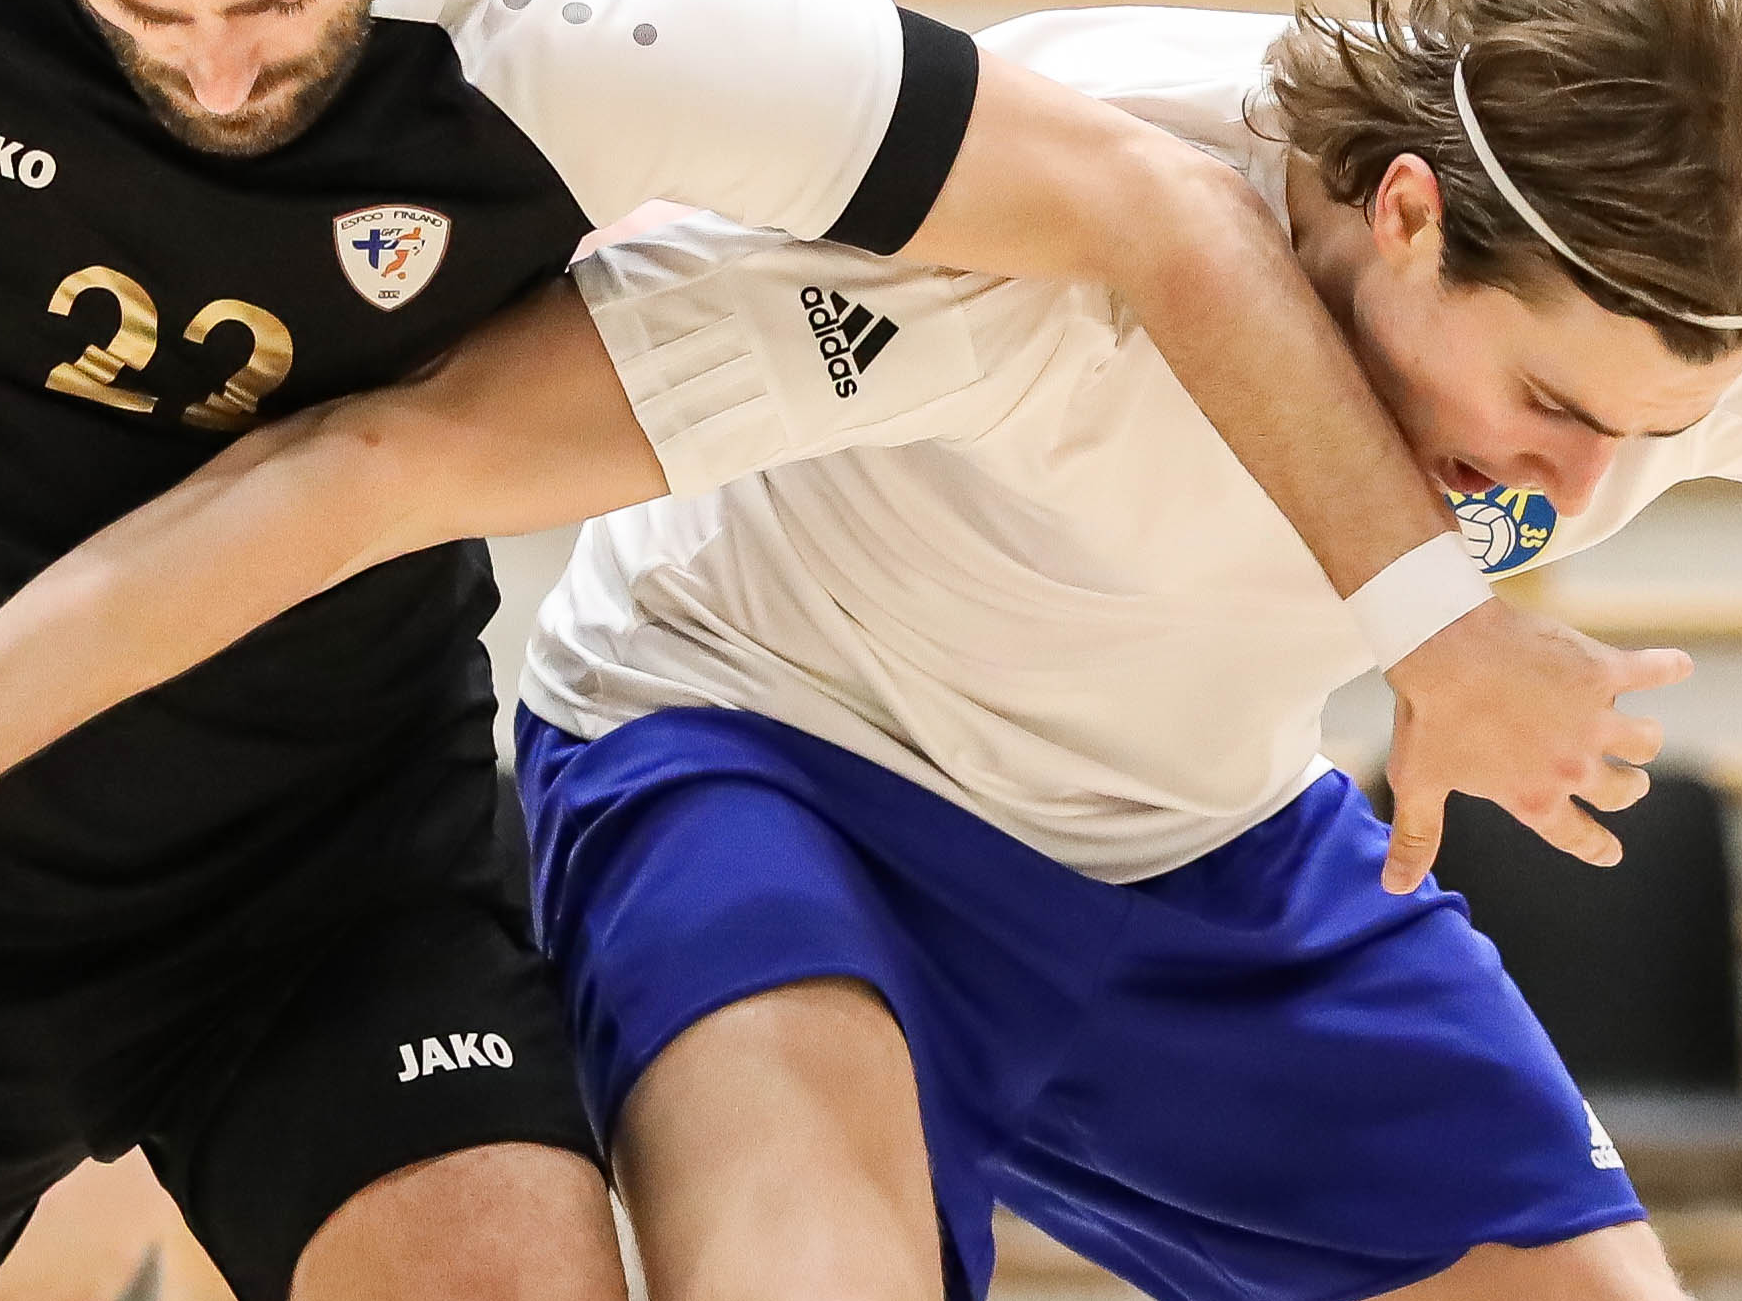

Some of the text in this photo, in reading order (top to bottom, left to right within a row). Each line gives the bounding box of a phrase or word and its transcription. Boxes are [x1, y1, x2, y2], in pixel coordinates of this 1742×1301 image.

[341, 211, 443, 230] ESPOO FINLAND
[381, 228, 403, 236] GFT
[45, 265, 294, 432] 22
[800, 286, 858, 399] adidas
[397, 1033, 514, 1083] JAKO
